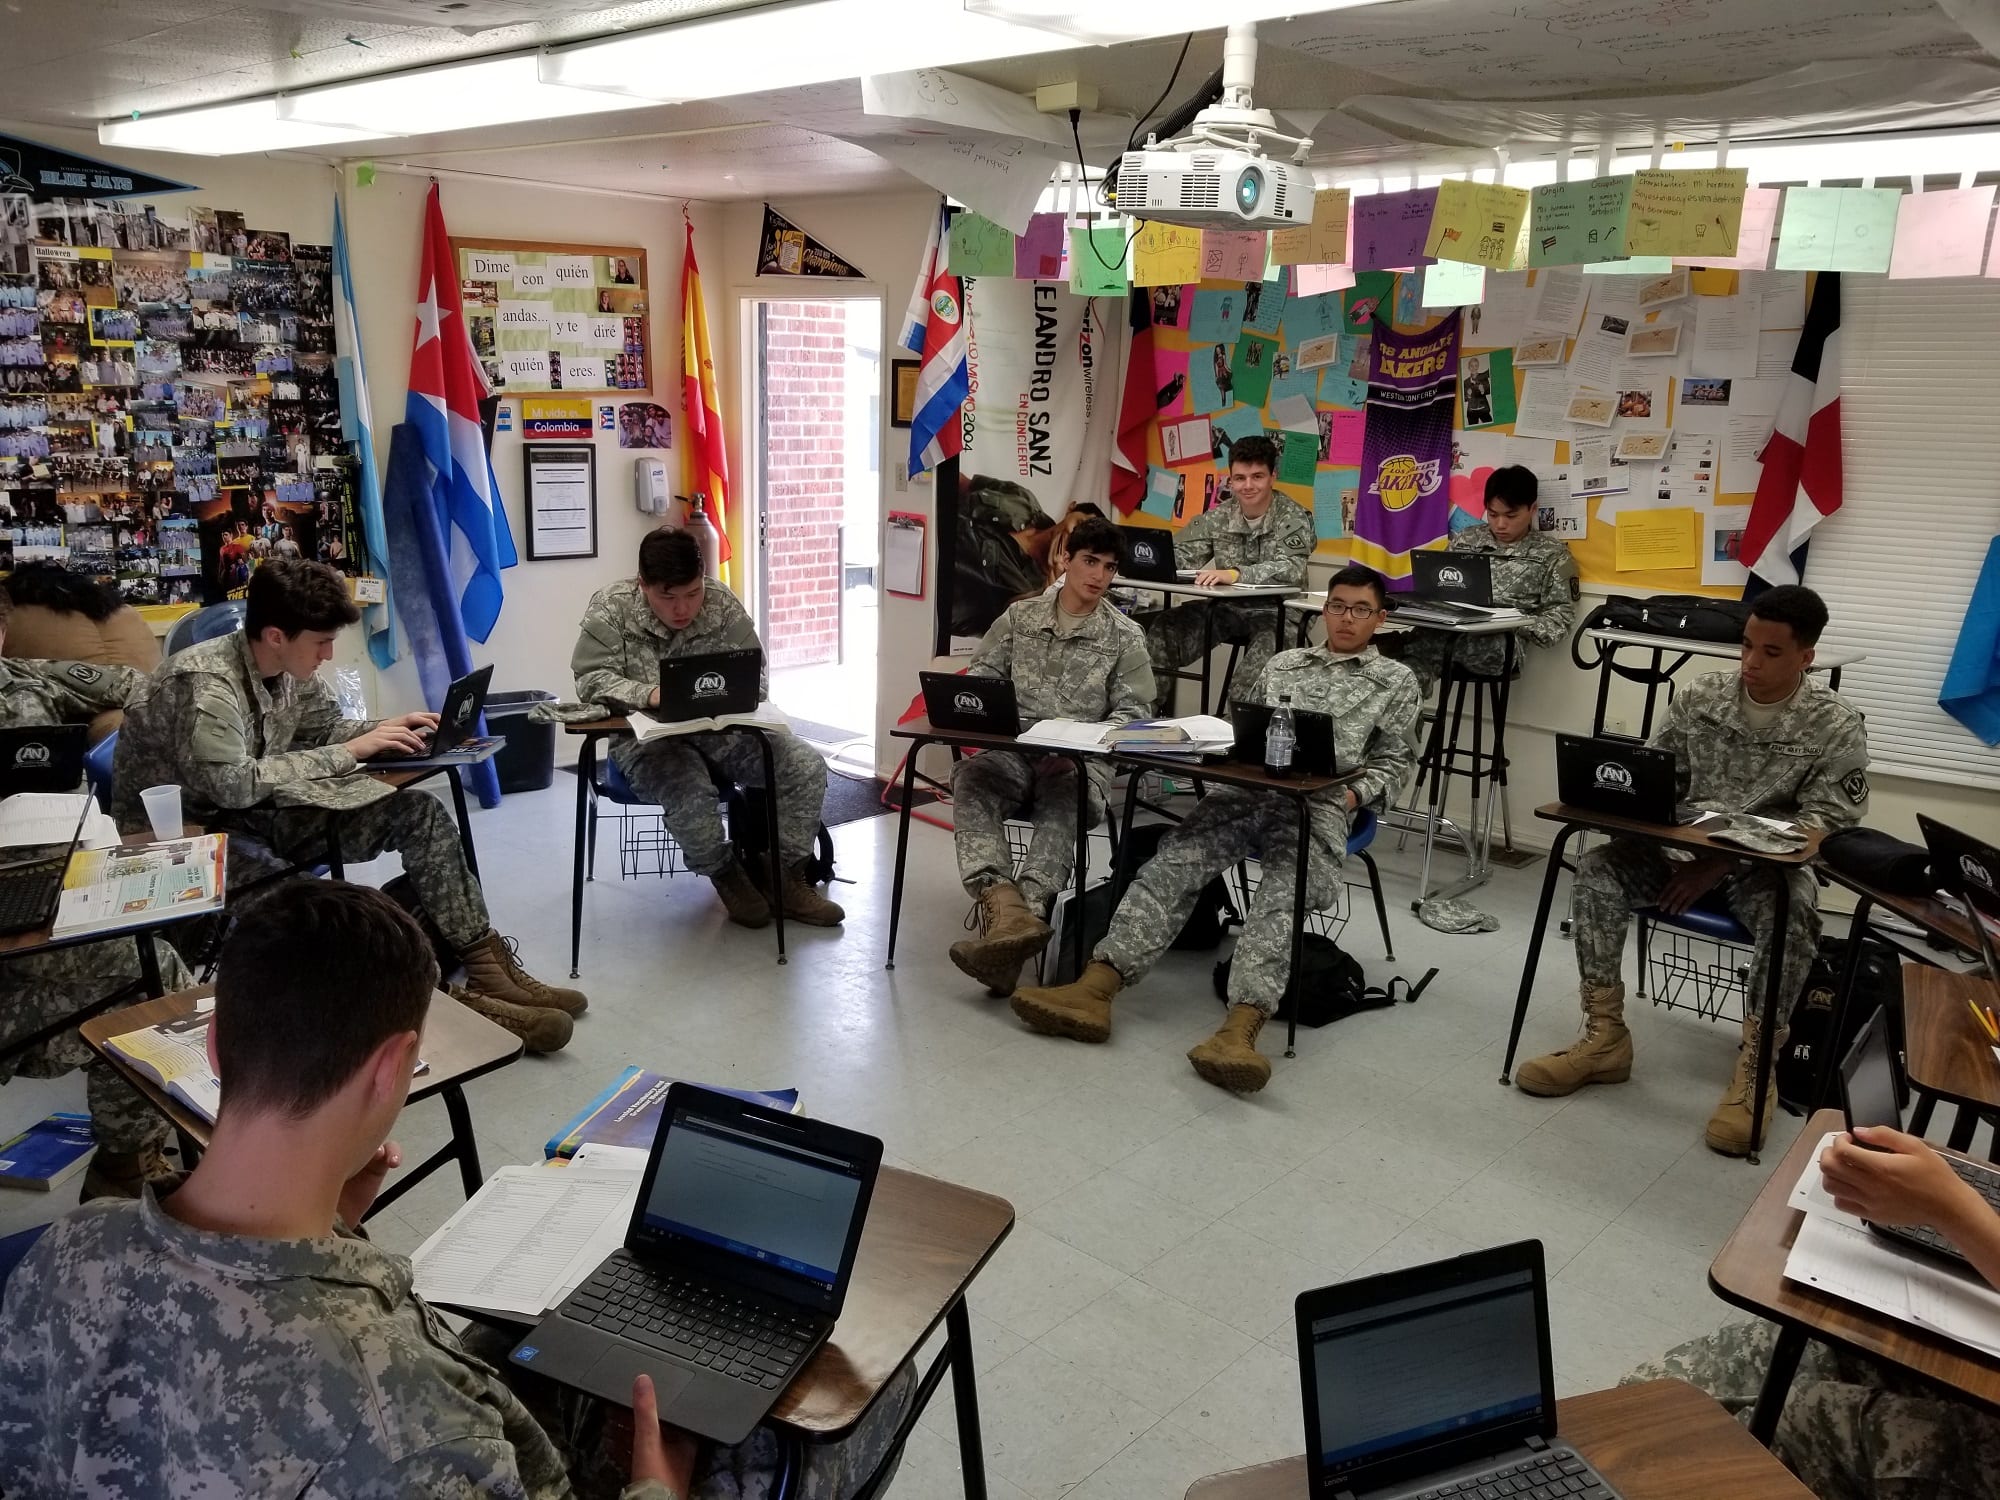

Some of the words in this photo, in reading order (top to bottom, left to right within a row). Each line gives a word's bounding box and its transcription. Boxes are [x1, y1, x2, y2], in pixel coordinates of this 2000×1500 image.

[40, 170, 87, 187] BLUE
[91, 175, 133, 191] JAYS
[36, 247, 71, 257] Halloween
[475, 259, 510, 273] Dime
[522, 274, 544, 285] con
[555, 265, 589, 283] quién
[502, 308, 548, 323] andas...
[556, 322, 564, 335] y
[567, 320, 578, 332] te
[593, 325, 616, 338] diré
[1030, 280, 1058, 402] EJANDRO
[510, 357, 544, 376] quién
[569, 366, 596, 377] eres.
[1018, 393, 1029, 409] EN
[532, 408, 543, 417] Mi
[547, 407, 567, 417] vida
[534, 421, 580, 432] Colombia
[963, 412, 976, 453] 2004
[1016, 412, 1029, 476] CONCIERTO
[1028, 411, 1052, 477] SANZ
[1443, 569, 1459, 581] AN
[226, 592, 244, 601] THE
[700, 676, 720, 689] AN
[959, 695, 978, 707] AN
[21, 748, 43, 760] AN
[1602, 766, 1625, 783] AN
